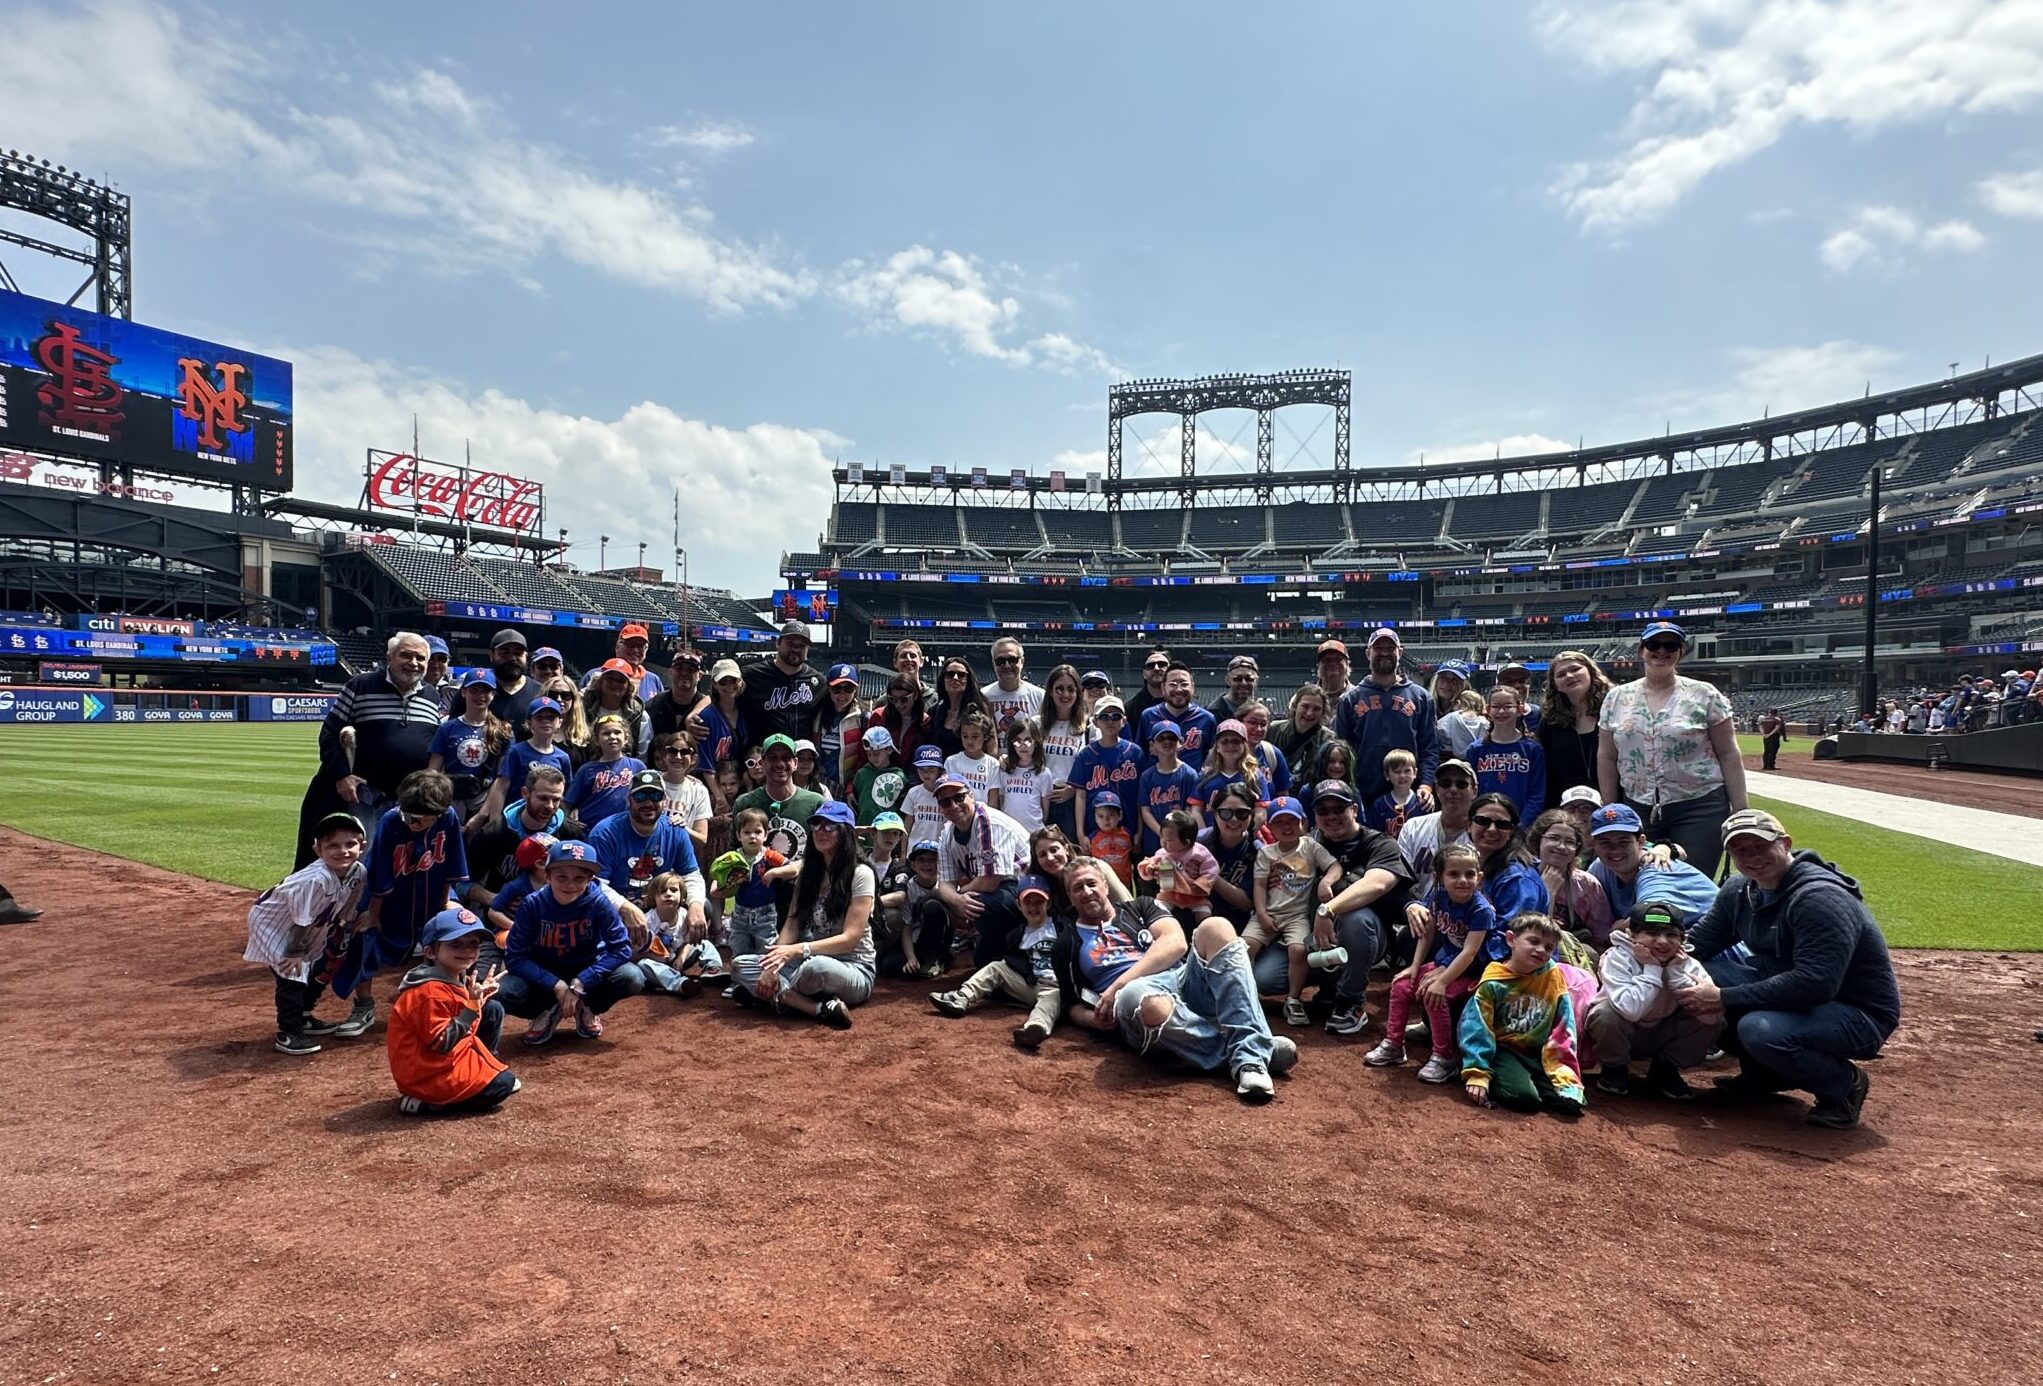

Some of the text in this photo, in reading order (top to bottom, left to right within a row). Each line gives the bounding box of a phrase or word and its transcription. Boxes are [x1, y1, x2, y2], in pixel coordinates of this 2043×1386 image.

[44, 472, 174, 501] new balance
[89, 618, 114, 630] citi
[53, 670, 90, 680] $1,500
[764, 682, 813, 710] Mets
[16, 700, 79, 711] HAUGLAND
[288, 698, 328, 707] CAESARS
[1354, 694, 1417, 717] METS
[16, 711, 56, 721] GROUP
[115, 710, 135, 721] 380
[144, 711, 171, 719] GOYA
[178, 711, 203, 719] GOYA
[209, 711, 233, 719] GOYA
[1047, 735, 1076, 747] IBLEY
[1045, 745, 1074, 756] IBLEY
[1478, 757, 1530, 773] METS
[1086, 760, 1138, 790] Mets
[393, 830, 447, 879] Met
